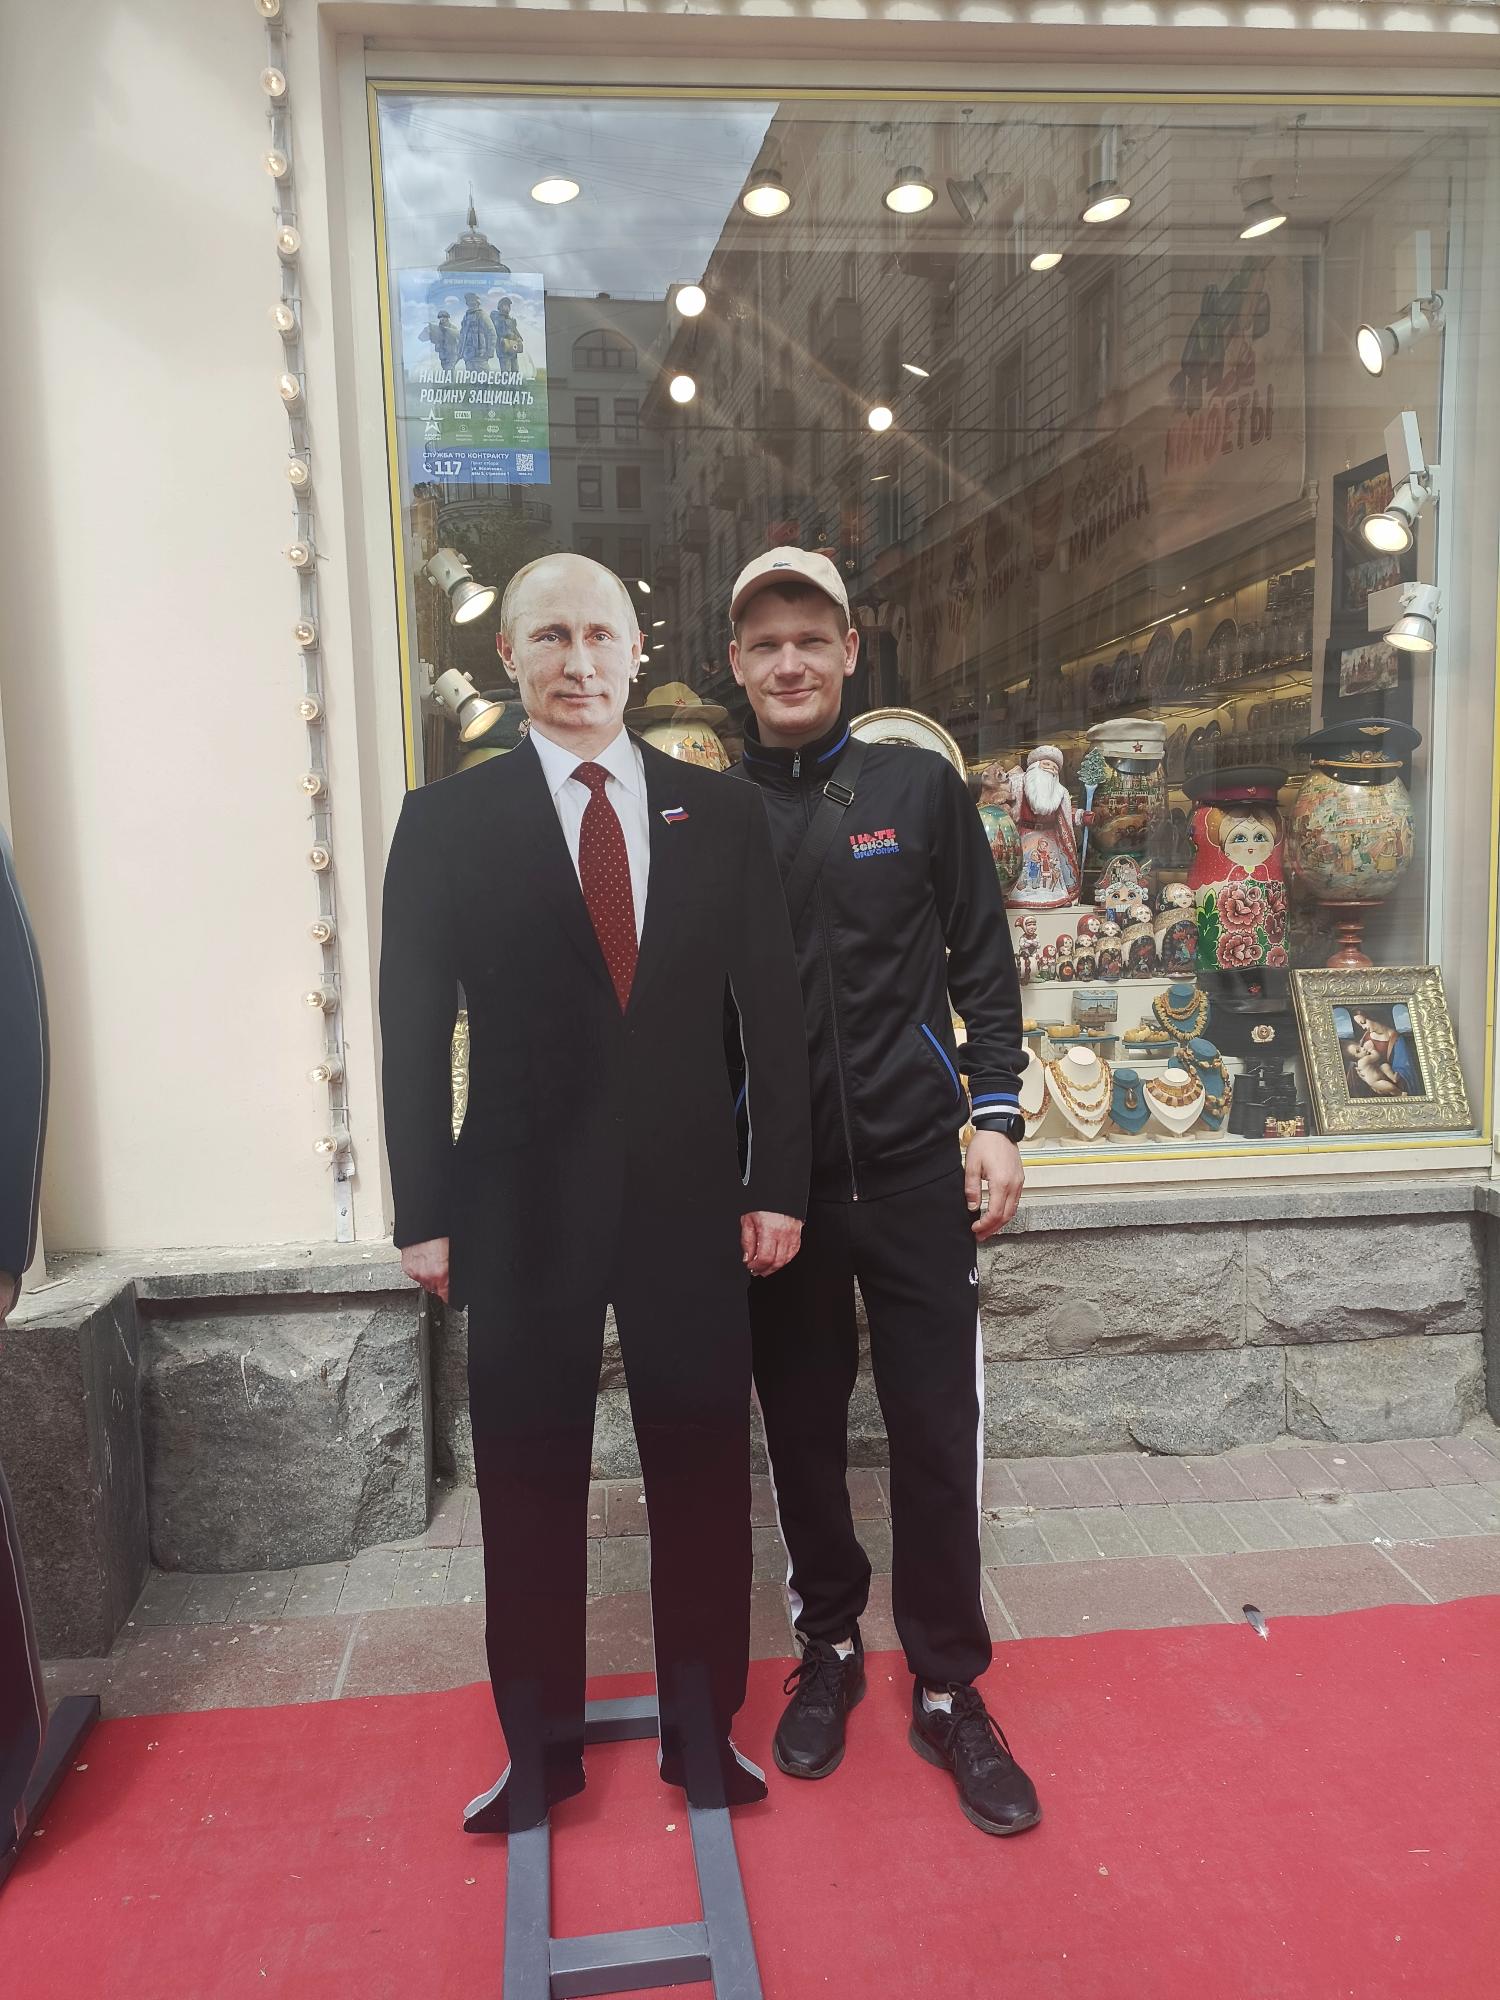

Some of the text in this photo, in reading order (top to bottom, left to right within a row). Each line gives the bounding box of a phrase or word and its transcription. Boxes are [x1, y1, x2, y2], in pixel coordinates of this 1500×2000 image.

[419, 369, 452, 384] НАША
[455, 369, 524, 386] ПРОФЕССИЯ
[420, 388, 534, 406] РОДИНУ ЗАЩИЩАТЬ
[467, 452, 510, 460] КОНТРАКТУ
[434, 460, 462, 476] 117
[852, 838, 899, 852] SCHOOL
